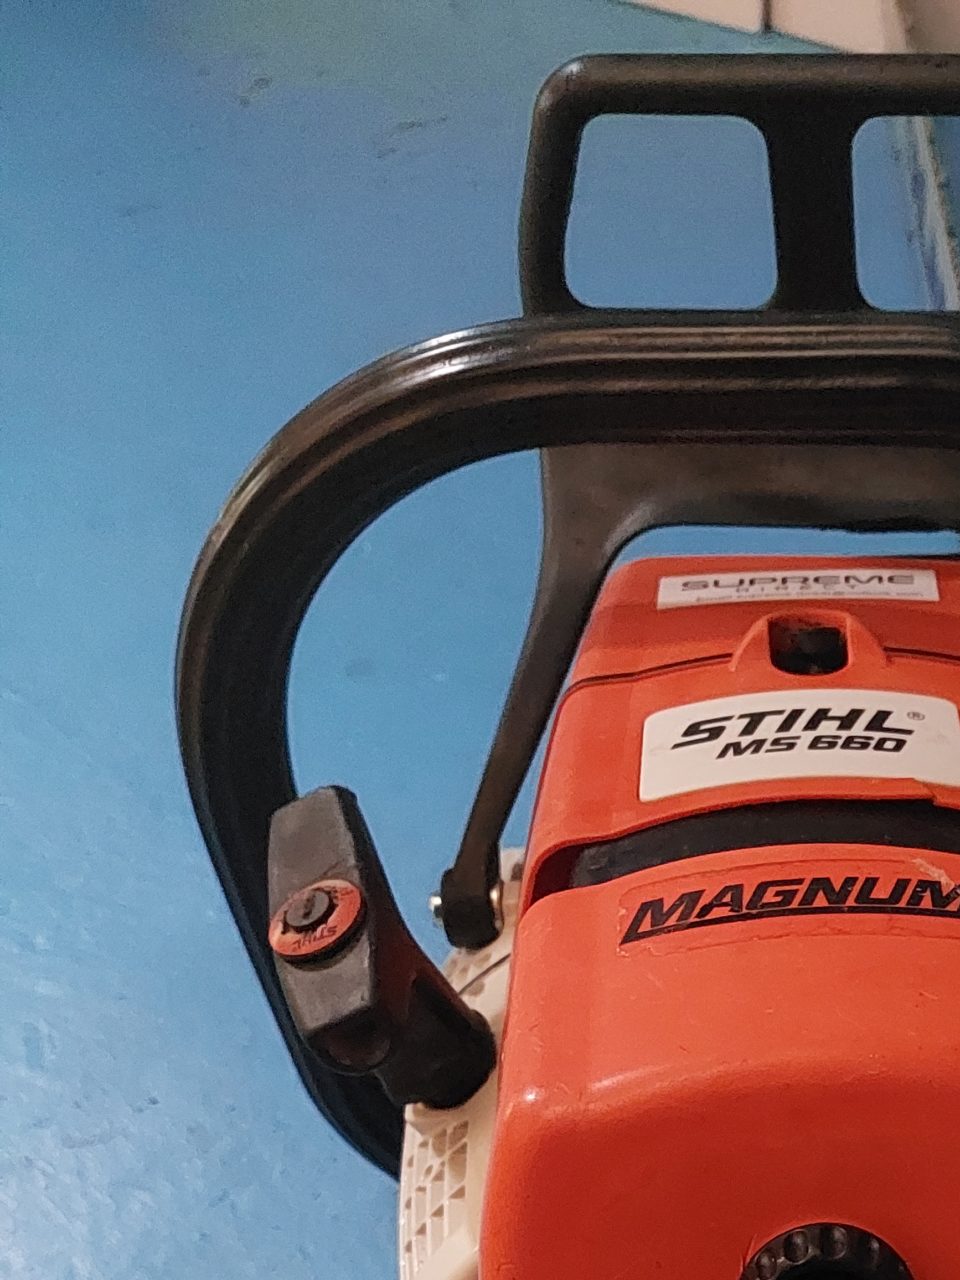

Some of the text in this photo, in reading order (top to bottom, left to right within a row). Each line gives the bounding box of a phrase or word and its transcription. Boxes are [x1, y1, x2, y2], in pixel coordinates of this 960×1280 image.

[681, 574, 914, 591] SUPREME
[671, 707, 915, 750] STIHL
[715, 735, 908, 760] MS 660
